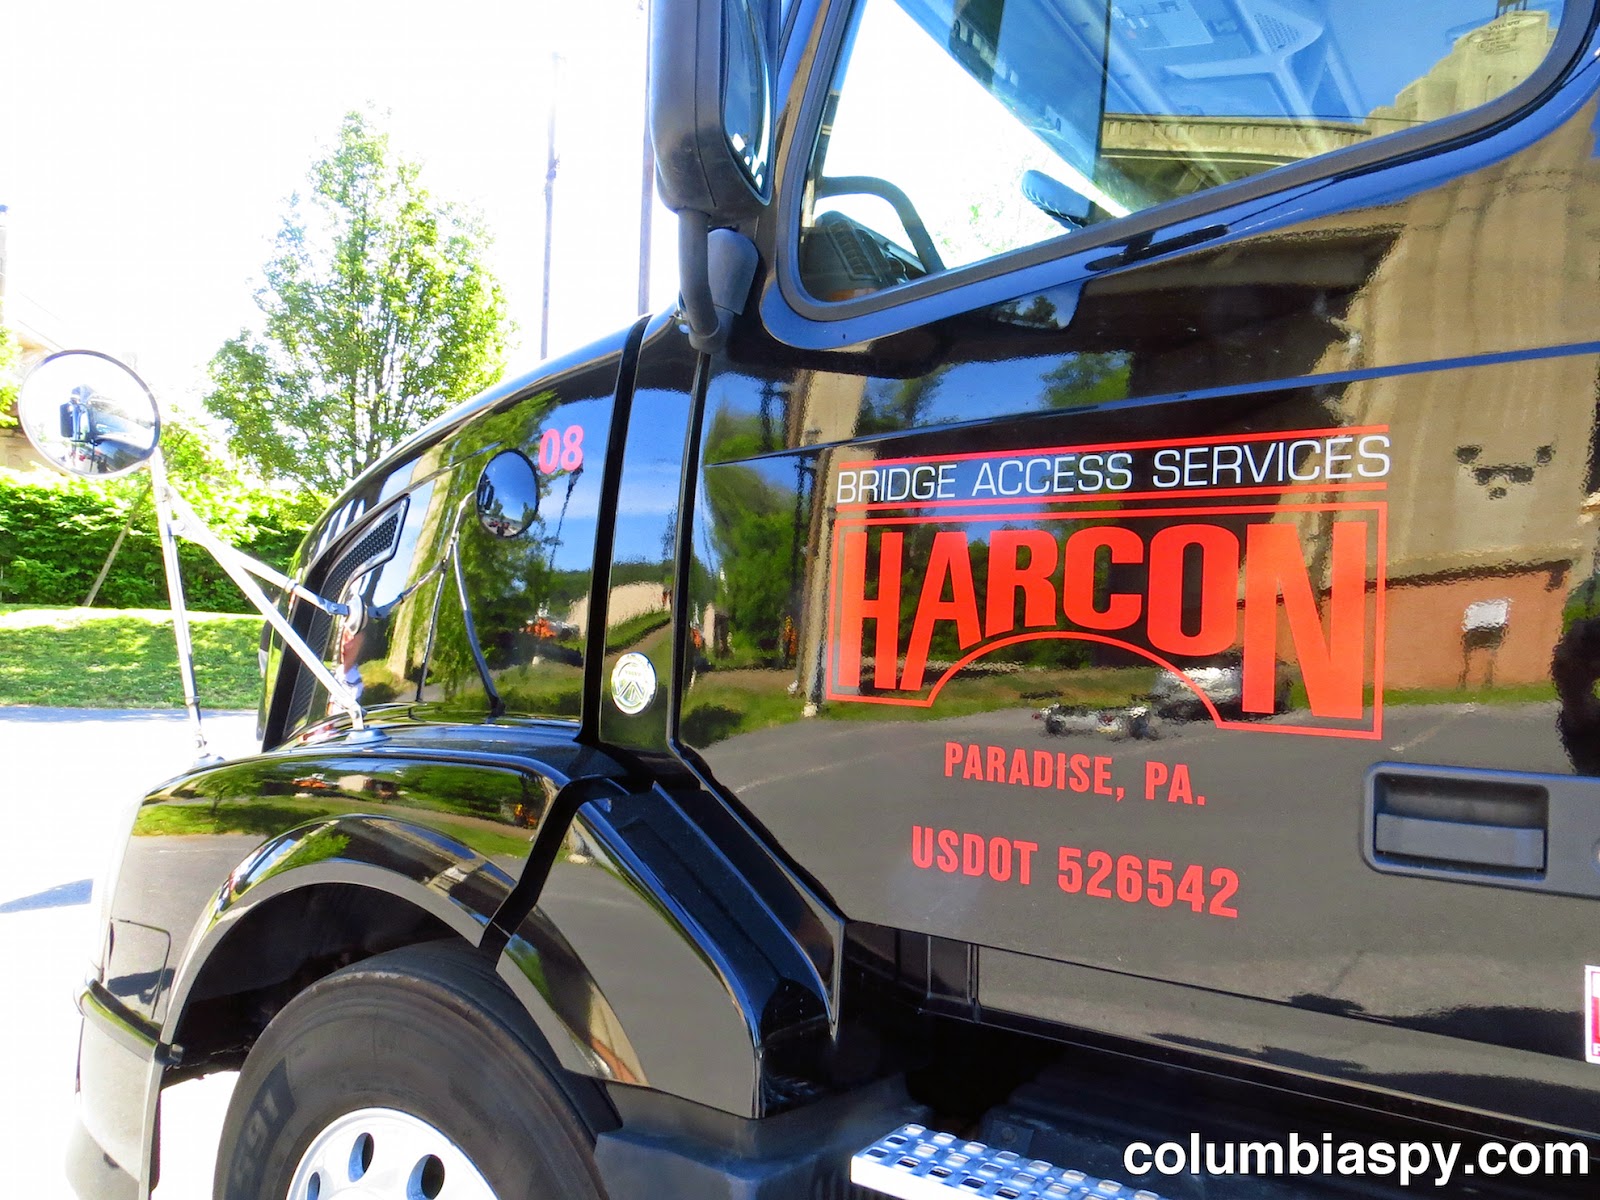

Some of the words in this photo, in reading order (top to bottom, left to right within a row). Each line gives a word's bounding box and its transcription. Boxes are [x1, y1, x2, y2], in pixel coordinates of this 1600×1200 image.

[538, 424, 584, 475] 08
[837, 463, 957, 504] BRIDGE
[972, 452, 1133, 496] ACCESS
[1152, 435, 1391, 488] SERVICES
[837, 521, 1368, 720] HARCON
[944, 741, 1125, 802] PARADISE,
[1145, 760, 1206, 806] PA.
[912, 825, 1038, 885] USDOT
[1057, 846, 1239, 918] 526542
